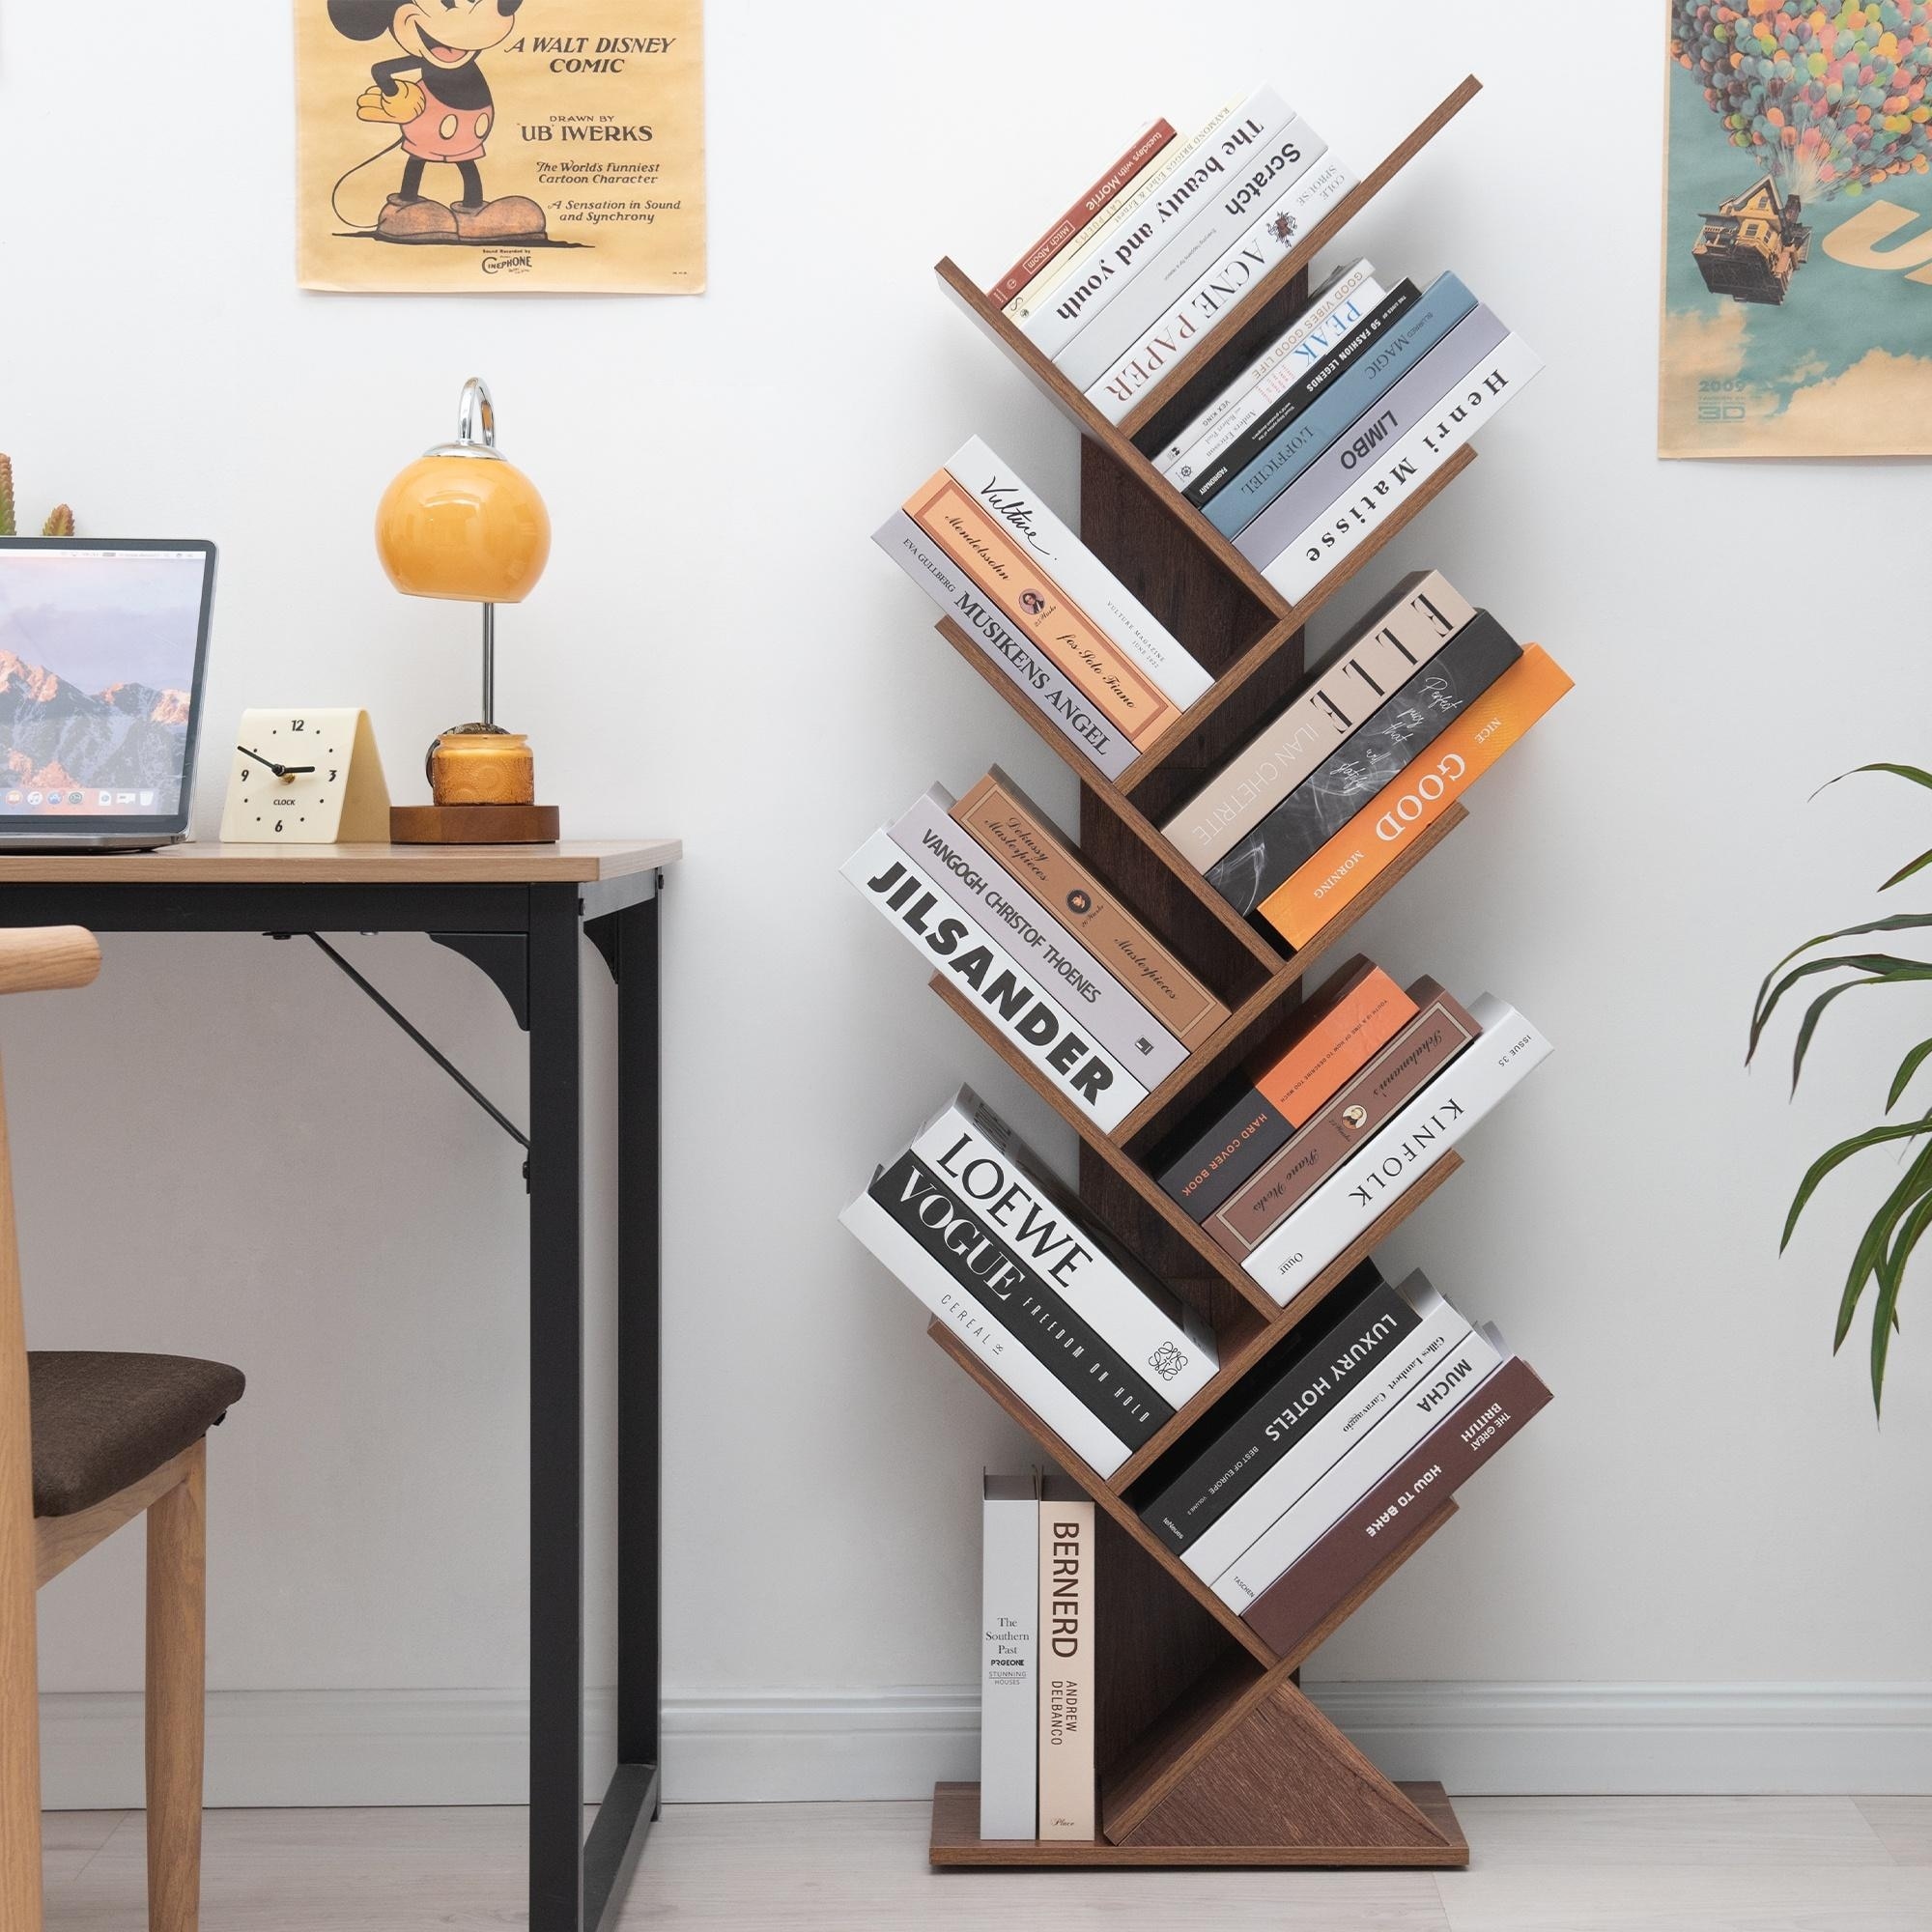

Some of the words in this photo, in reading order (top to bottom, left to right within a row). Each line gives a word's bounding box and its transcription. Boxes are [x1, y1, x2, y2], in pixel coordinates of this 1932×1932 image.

[504, 37, 526, 53] A
[532, 37, 588, 53] WALT
[595, 37, 676, 53] DISNEY
[550, 58, 625, 73] COMIC
[561, 125, 653, 142] IWERKS
[1193, 107, 1230, 144] RAYMOND
[1221, 119, 1264, 156] The
[1132, 131, 1162, 161] tuesdays
[1166, 143, 1194, 171] BRIGGS
[536, 161, 558, 173] The
[560, 159, 603, 173] World's
[607, 161, 660, 173] Funniest
[538, 174, 588, 185] Cartoon
[592, 174, 658, 185] Character
[1118, 161, 1134, 177] with
[1225, 143, 1301, 215] Scratch
[1086, 175, 1121, 211] Morrie
[1156, 156, 1225, 223] beauty
[1296, 165, 1337, 206] SPROUSE
[1320, 175, 1345, 200] COLE
[548, 200, 562, 210] A
[565, 200, 625, 210] Sensation
[629, 200, 640, 210] in
[644, 200, 681, 210] Sound
[559, 212, 583, 221] and
[586, 211, 655, 224] Synchrony
[1046, 225, 1069, 246] Mitch
[1115, 223, 1153, 266] and
[1025, 244, 1050, 269] Albom
[1056, 259, 1115, 320] youth
[1191, 240, 1265, 319] ACNE
[1334, 271, 1363, 300] GOOD
[1304, 300, 1335, 329] VIBES
[1370, 319, 1381, 330] 50
[1406, 312, 1434, 338] BLURRED
[1274, 328, 1304, 357] GOOD
[1293, 302, 1365, 367] PEAK
[1338, 328, 1372, 361] FASHION
[1104, 314, 1198, 401] PAPER
[1252, 356, 1275, 380] LIFE
[1364, 334, 1410, 380] MAGIC
[1306, 358, 1340, 392] LEGENDS
[1698, 380, 1747, 392] 2009
[1202, 412, 1218, 426] KING
[1217, 400, 1231, 412] VEX
[1422, 369, 1509, 453] Henri
[1698, 406, 1746, 419] 3D
[1340, 410, 1398, 469] LIMBO
[1240, 426, 1314, 495] L'OFFICIEL
[1197, 465, 1229, 497] FASHIONARY
[1306, 457, 1418, 561] Matisse
[902, 538, 918, 555] EVA
[918, 554, 956, 592] GULLBERG
[953, 590, 1051, 690] MUSIKENS
[1044, 690, 1111, 755] ANGEL
[1107, 601, 1134, 630] VULTURE
[1134, 630, 1165, 662] MAGAZINE
[1309, 593, 1455, 734] ELLE
[291, 719, 304, 732] 12
[1474, 717, 1502, 744] NICE
[1274, 723, 1319, 767] ILAN
[241, 769, 249, 782] 9
[328, 769, 338, 782] 3
[1192, 761, 1279, 848] CHETRITE
[1376, 753, 1465, 841] GOOD
[274, 819, 283, 833] 6
[984, 820, 1046, 881] Masterpieces
[1313, 850, 1364, 898] MORNING
[922, 828, 988, 895] VANGOGH
[984, 891, 1046, 948] CHRISTOF
[1042, 944, 1102, 1004] THOENES
[867, 860, 1115, 1107] JILSANDER
[1114, 939, 1176, 999] Masterpieces
[1509, 1035, 1532, 1056] ISSUE
[1498, 1056, 1509, 1066] 35
[1240, 1113, 1267, 1139] HARD
[1208, 1139, 1240, 1170] COVER
[1349, 1098, 1464, 1207] KINFOLK
[1181, 1169, 1209, 1196] BOOK
[936, 1132, 1094, 1288] LOEWE
[1278, 1253, 1303, 1275] Ouur
[900, 1165, 1026, 1301] VOGUE
[1022, 1297, 1085, 1358] FREEDOM
[1114, 1387, 1150, 1422] HOLD
[941, 1294, 990, 1345] CEREAL
[1330, 1314, 1398, 1381] LUXURY
[1422, 1337, 1444, 1356] Gilles
[1388, 1357, 1423, 1389] Lambert
[1416, 1358, 1472, 1412] MUCHA
[1264, 1377, 1331, 1441] HOTELS
[1343, 1392, 1386, 1432] Caravaggio
[1493, 1412, 1511, 1428] THE
[1470, 1426, 1495, 1451] GREAT
[1234, 1461, 1243, 1472] OF
[1242, 1446, 1259, 1463] BEST
[1208, 1469, 1235, 1494] EUROPE
[1413, 1464, 1442, 1493] HOW
[1397, 1492, 1415, 1507] TO
[1366, 1505, 1399, 1537] BAKE
[1051, 1521, 1080, 1659] BERNERD
[1234, 1576, 1255, 1598] TASCHEN
[985, 1631, 1030, 1641] Southern
[996, 1617, 1018, 1628] The
[998, 1644, 1017, 1655] Past
[1050, 1680, 1064, 1746] DELBANCO
[1065, 1680, 1078, 1732] ANDREW
